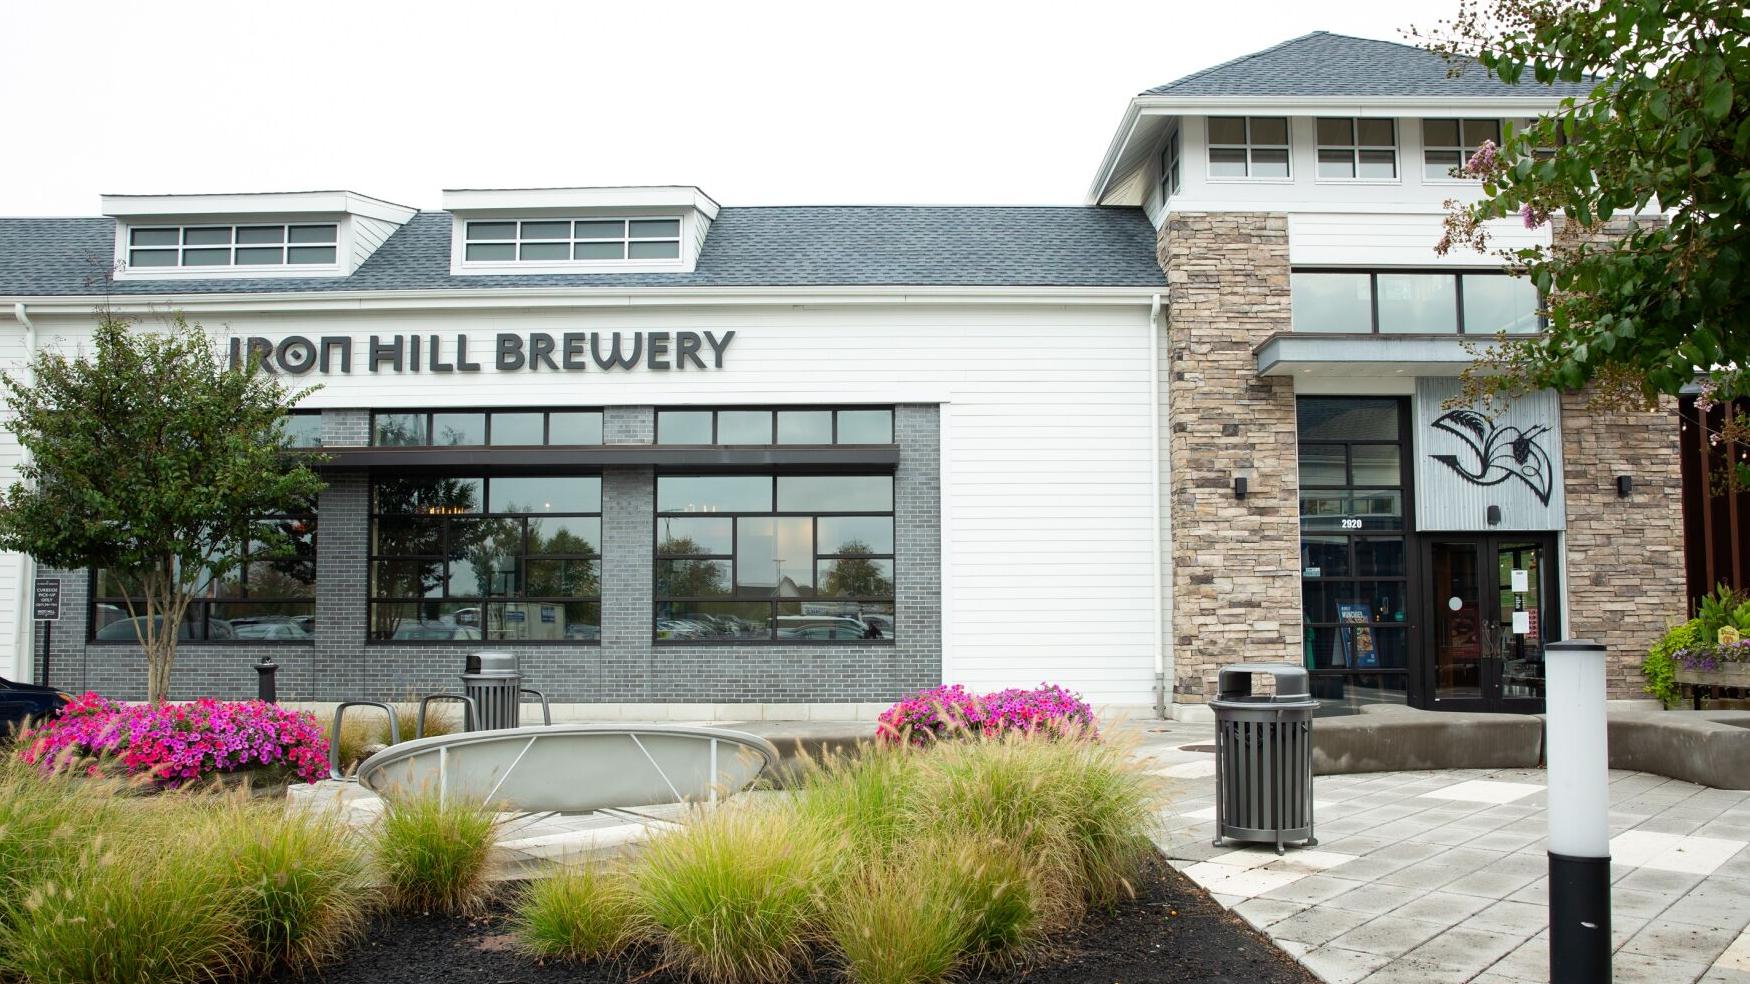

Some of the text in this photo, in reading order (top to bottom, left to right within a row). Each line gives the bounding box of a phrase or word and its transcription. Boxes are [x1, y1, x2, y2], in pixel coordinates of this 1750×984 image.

[229, 331, 736, 374] IRON HILL BREWERY
[1341, 519, 1362, 529] 2920
